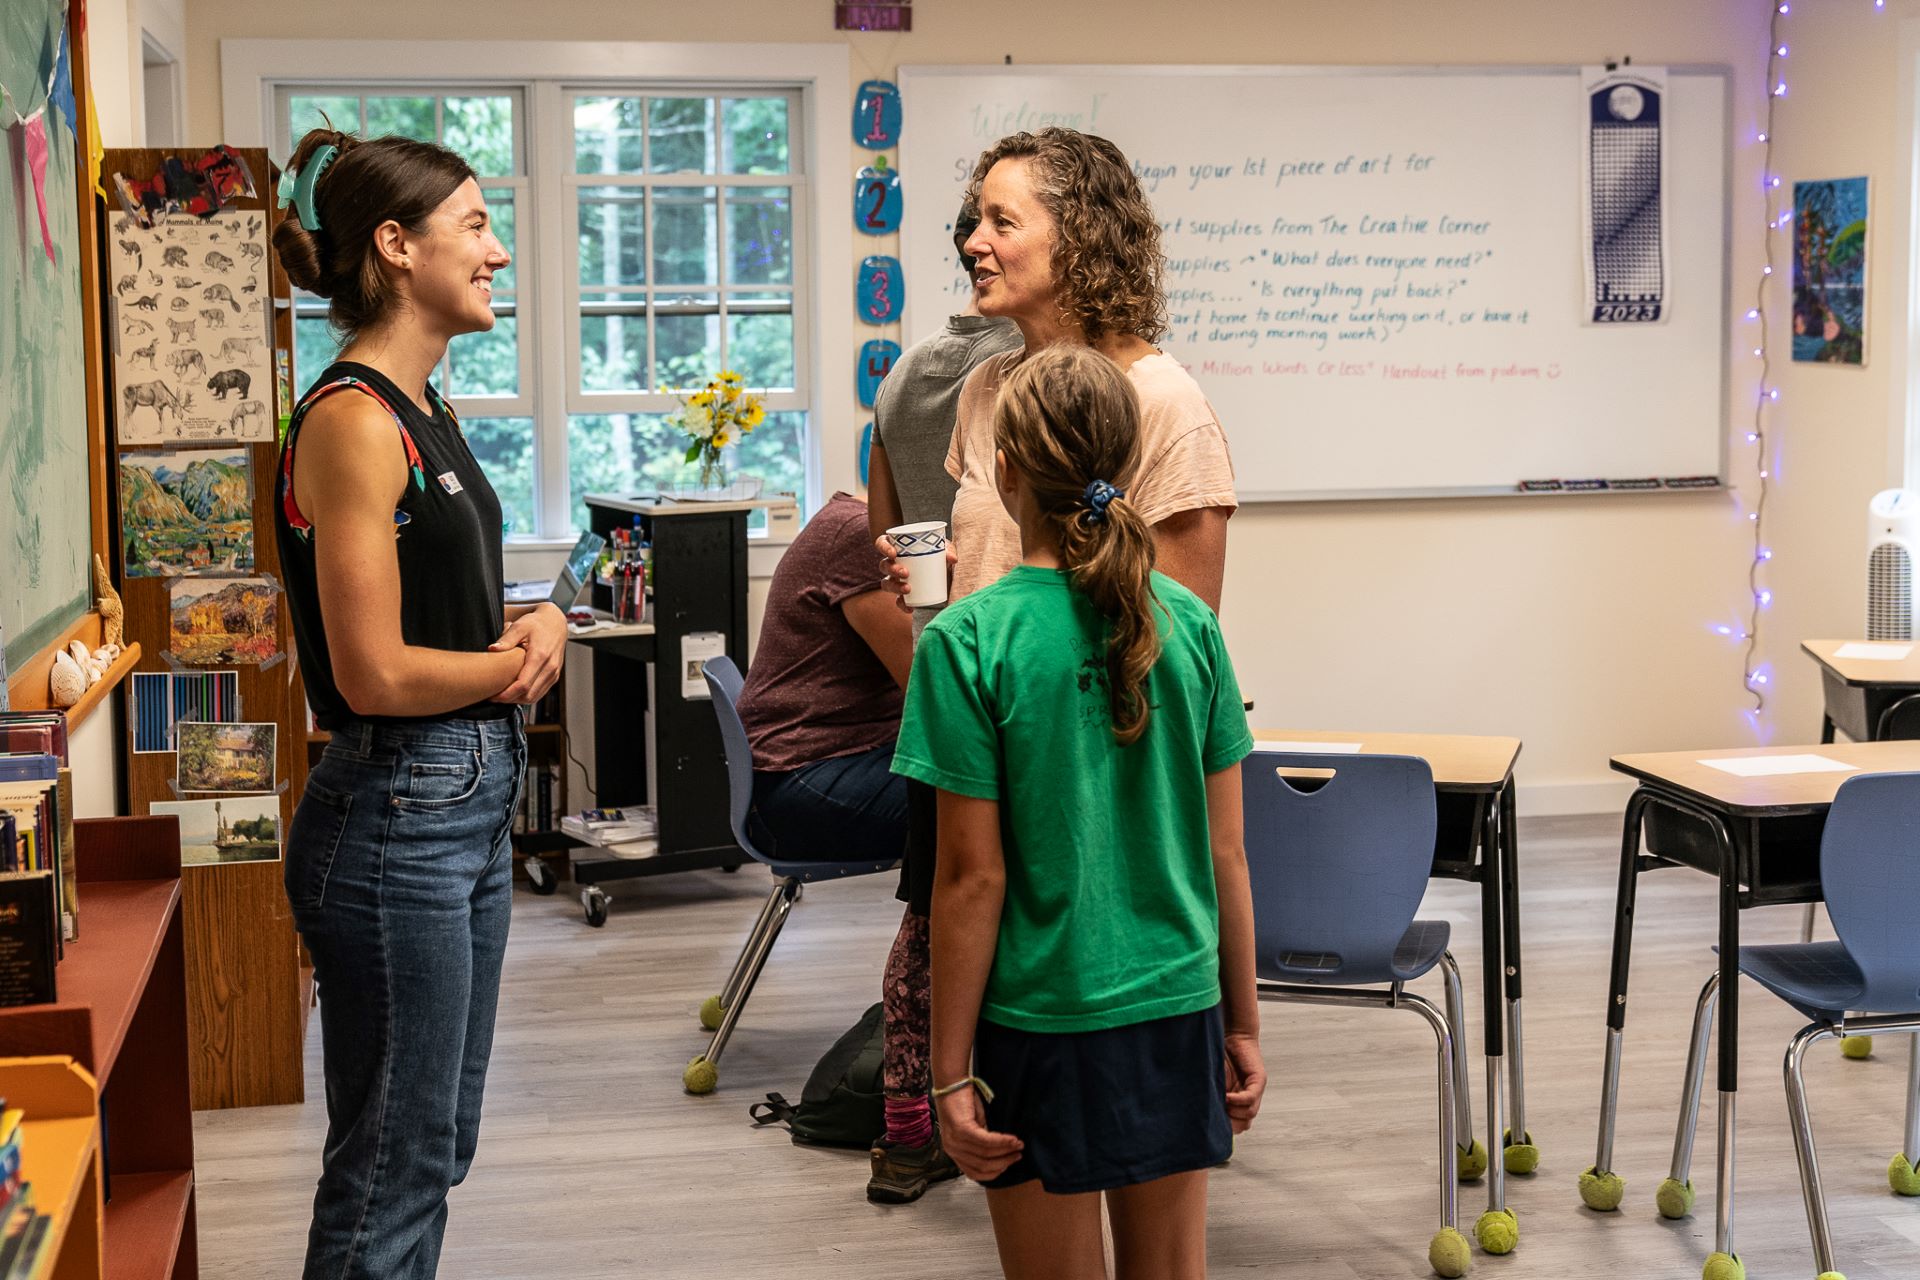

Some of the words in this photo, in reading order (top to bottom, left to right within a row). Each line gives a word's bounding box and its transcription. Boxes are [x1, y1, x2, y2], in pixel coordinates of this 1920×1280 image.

[866, 96, 887, 141] 1
[1188, 163, 1233, 190] your
[1275, 155, 1326, 188] piece
[1334, 154, 1355, 176] of
[1359, 154, 1392, 175] art
[1406, 152, 1435, 172] for
[867, 182, 886, 228] 2
[1189, 217, 1264, 243] supplies
[1272, 216, 1314, 236] from
[1319, 213, 1349, 236] The
[1359, 212, 1430, 236] Creative
[1438, 213, 1492, 236] Corner
[1325, 250, 1360, 268] does
[1364, 255, 1428, 282] everyone
[870, 271, 890, 318] 3
[1282, 282, 1364, 311] everything
[1370, 284, 1398, 306] put
[1173, 309, 1201, 326] art
[1210, 309, 1249, 326] home
[1256, 306, 1271, 323] to
[1274, 307, 1340, 325] continue
[1348, 307, 1408, 333] working
[1600, 305, 1656, 321] 2023
[1186, 330, 1199, 344] it
[1208, 328, 1260, 350] during
[1266, 329, 1330, 351] morning
[1201, 360, 1254, 377] Million
